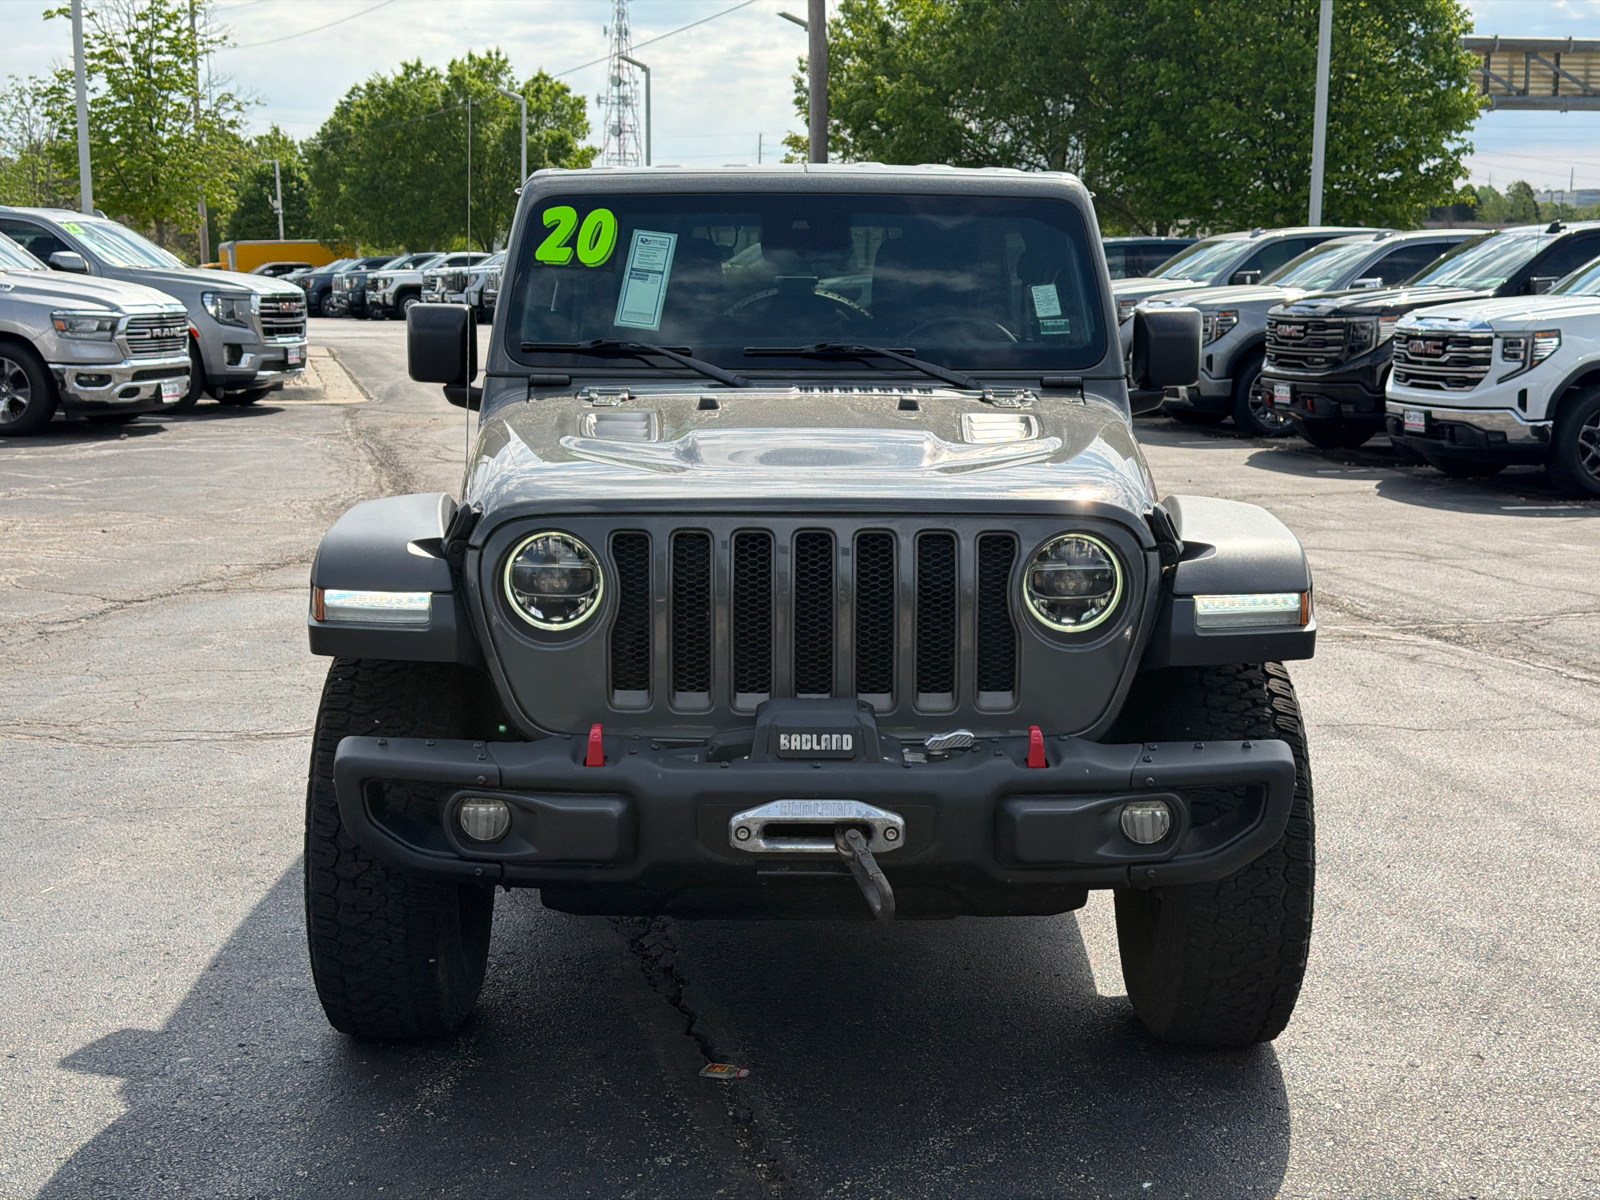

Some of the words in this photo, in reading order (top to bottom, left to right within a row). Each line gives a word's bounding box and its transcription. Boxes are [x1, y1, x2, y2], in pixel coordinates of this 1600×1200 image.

[535, 206, 618, 268] 20
[152, 327, 180, 338] RAM
[1276, 324, 1304, 337] GMC
[1408, 340, 1443, 354] GMC
[780, 733, 853, 751] BADLAND
[780, 801, 855, 817] BADLAND
